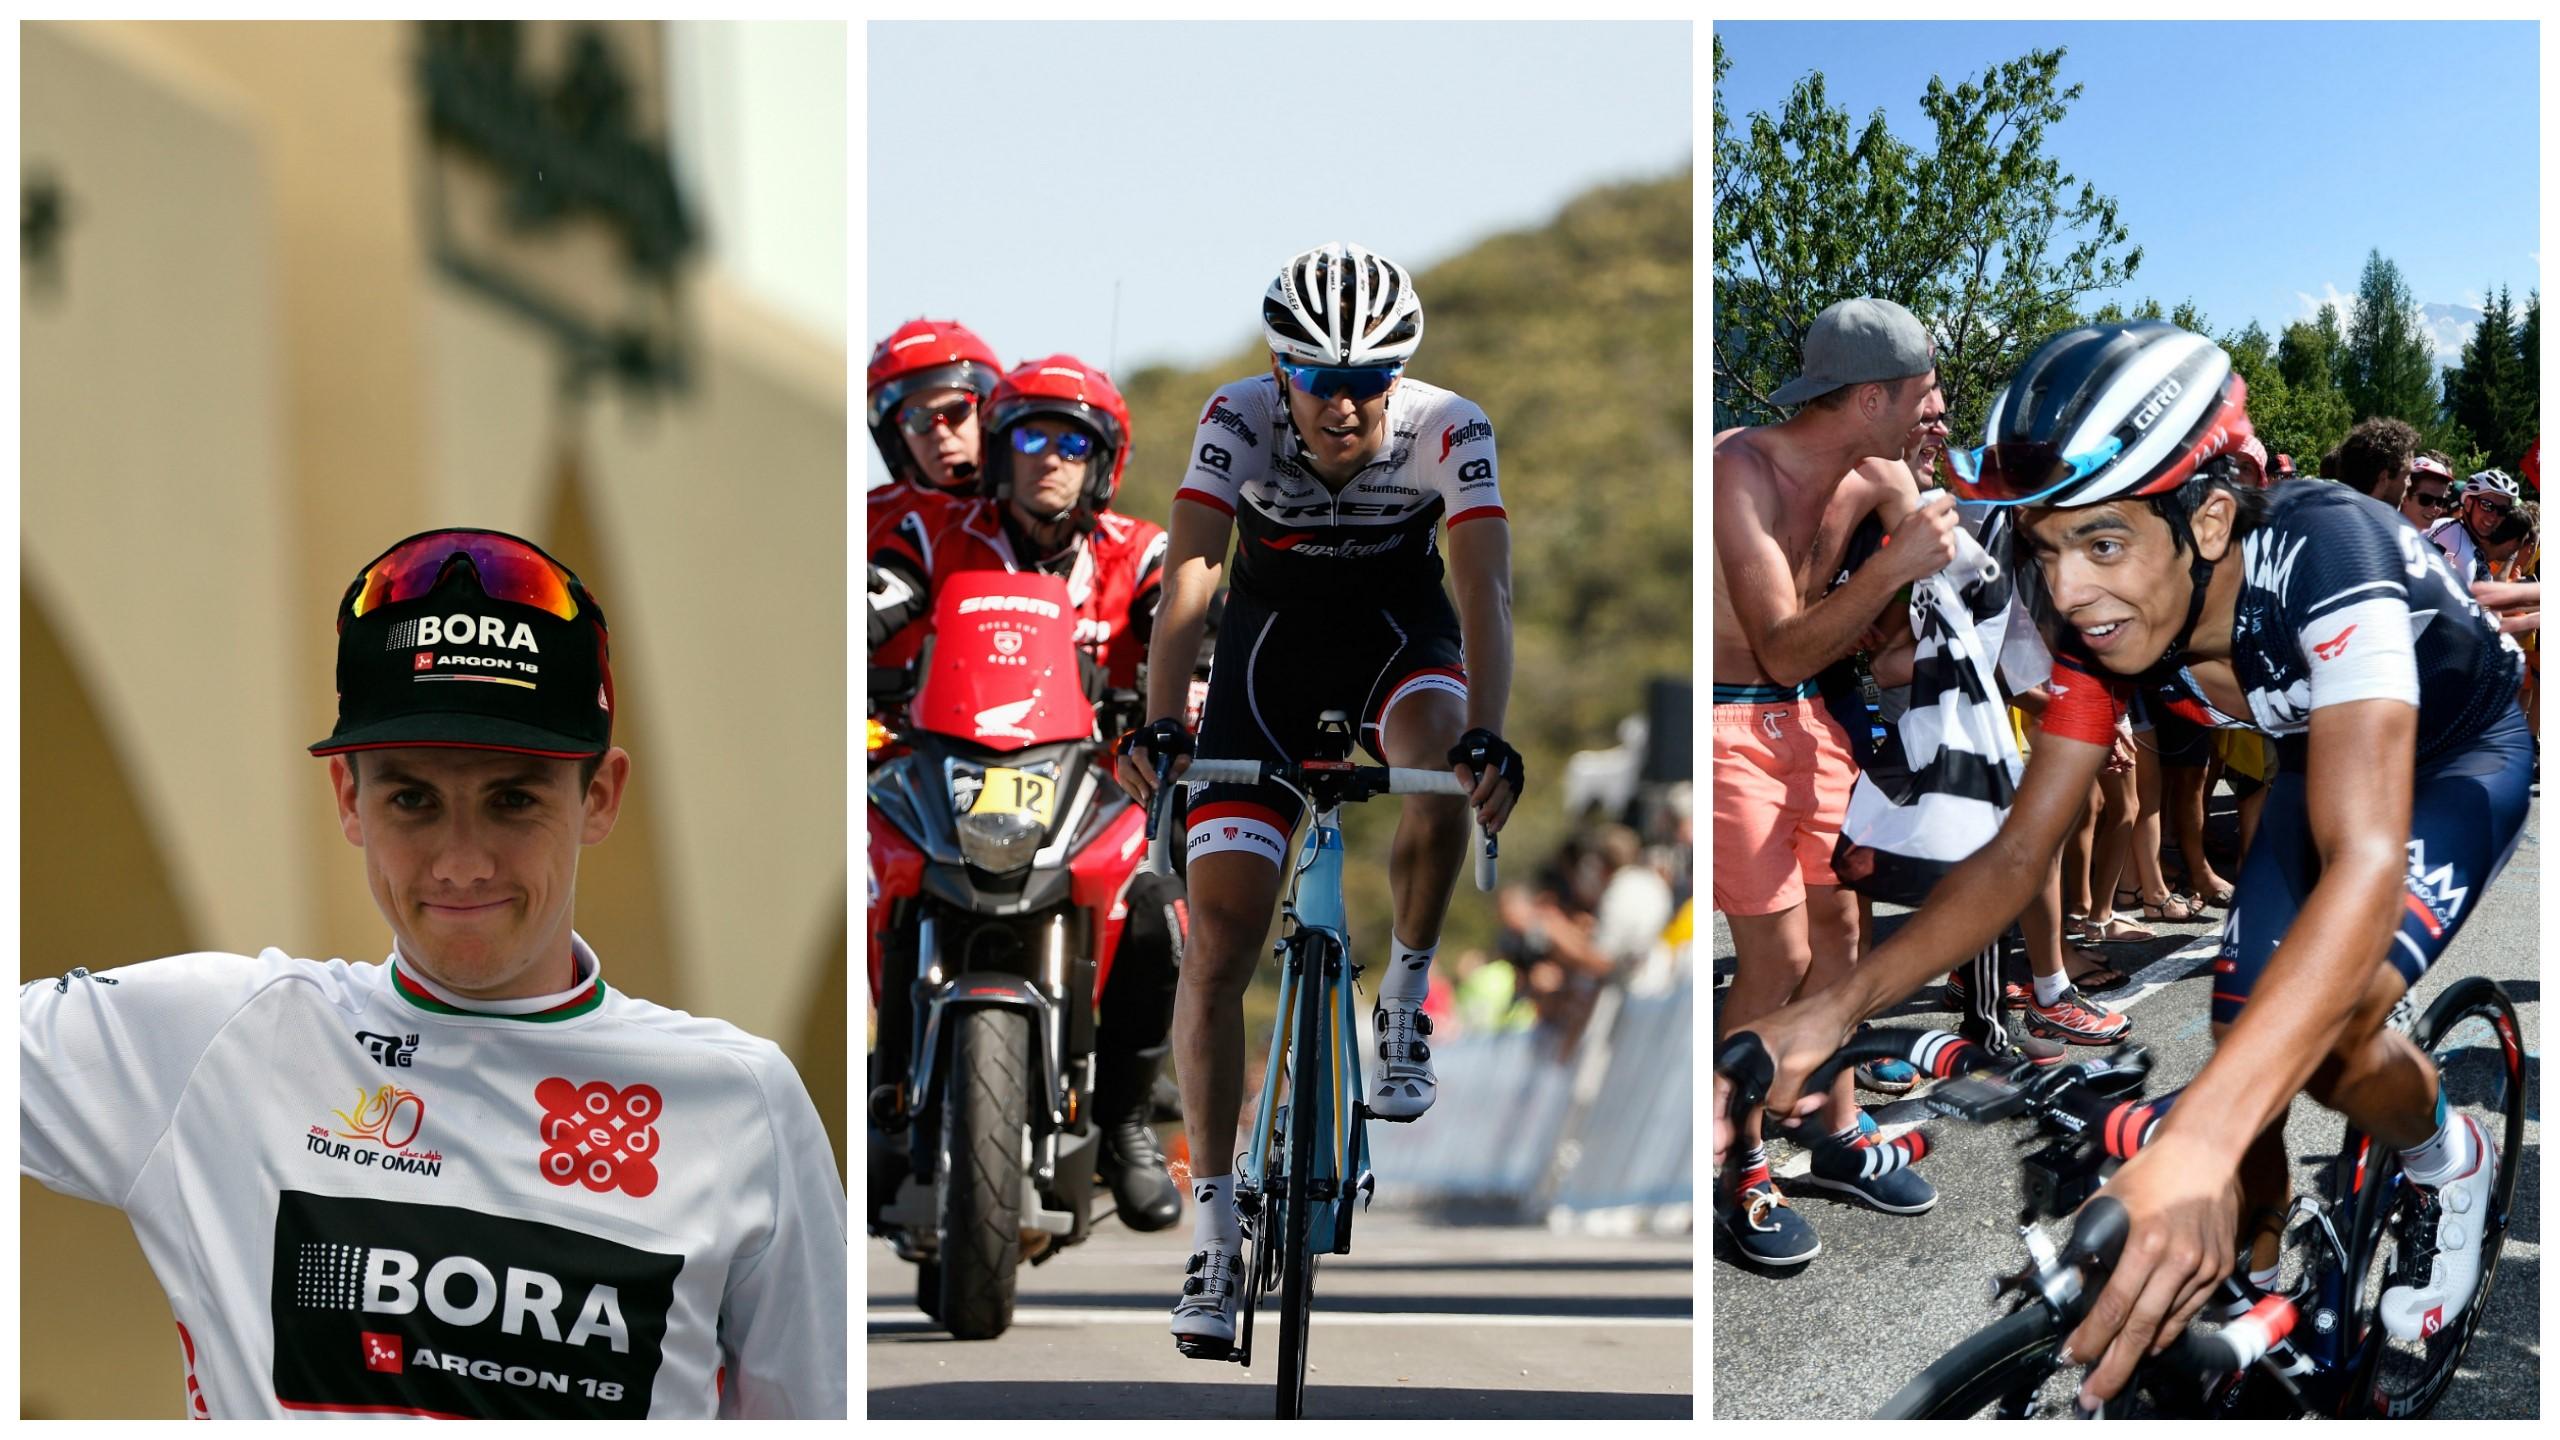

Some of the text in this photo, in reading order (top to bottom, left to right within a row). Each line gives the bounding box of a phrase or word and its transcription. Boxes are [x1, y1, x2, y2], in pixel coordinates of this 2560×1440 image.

[2134, 379, 2182, 430] GIRO
[1200, 443, 1232, 472] ca
[1458, 458, 1494, 482] ca
[1358, 484, 1420, 496] SHIMANO
[416, 613, 540, 653] BORA
[437, 655, 539, 674] ARGON 18
[1013, 776, 1044, 814] 12
[1242, 831, 1281, 855] TREK
[1396, 1007, 1407, 1063] BONTRAGER
[310, 1125, 329, 1137] 2016
[306, 1133, 442, 1178] TOUR OF OMAN
[361, 1247, 630, 1354] BORA
[411, 1348, 625, 1401] ARGON 18
